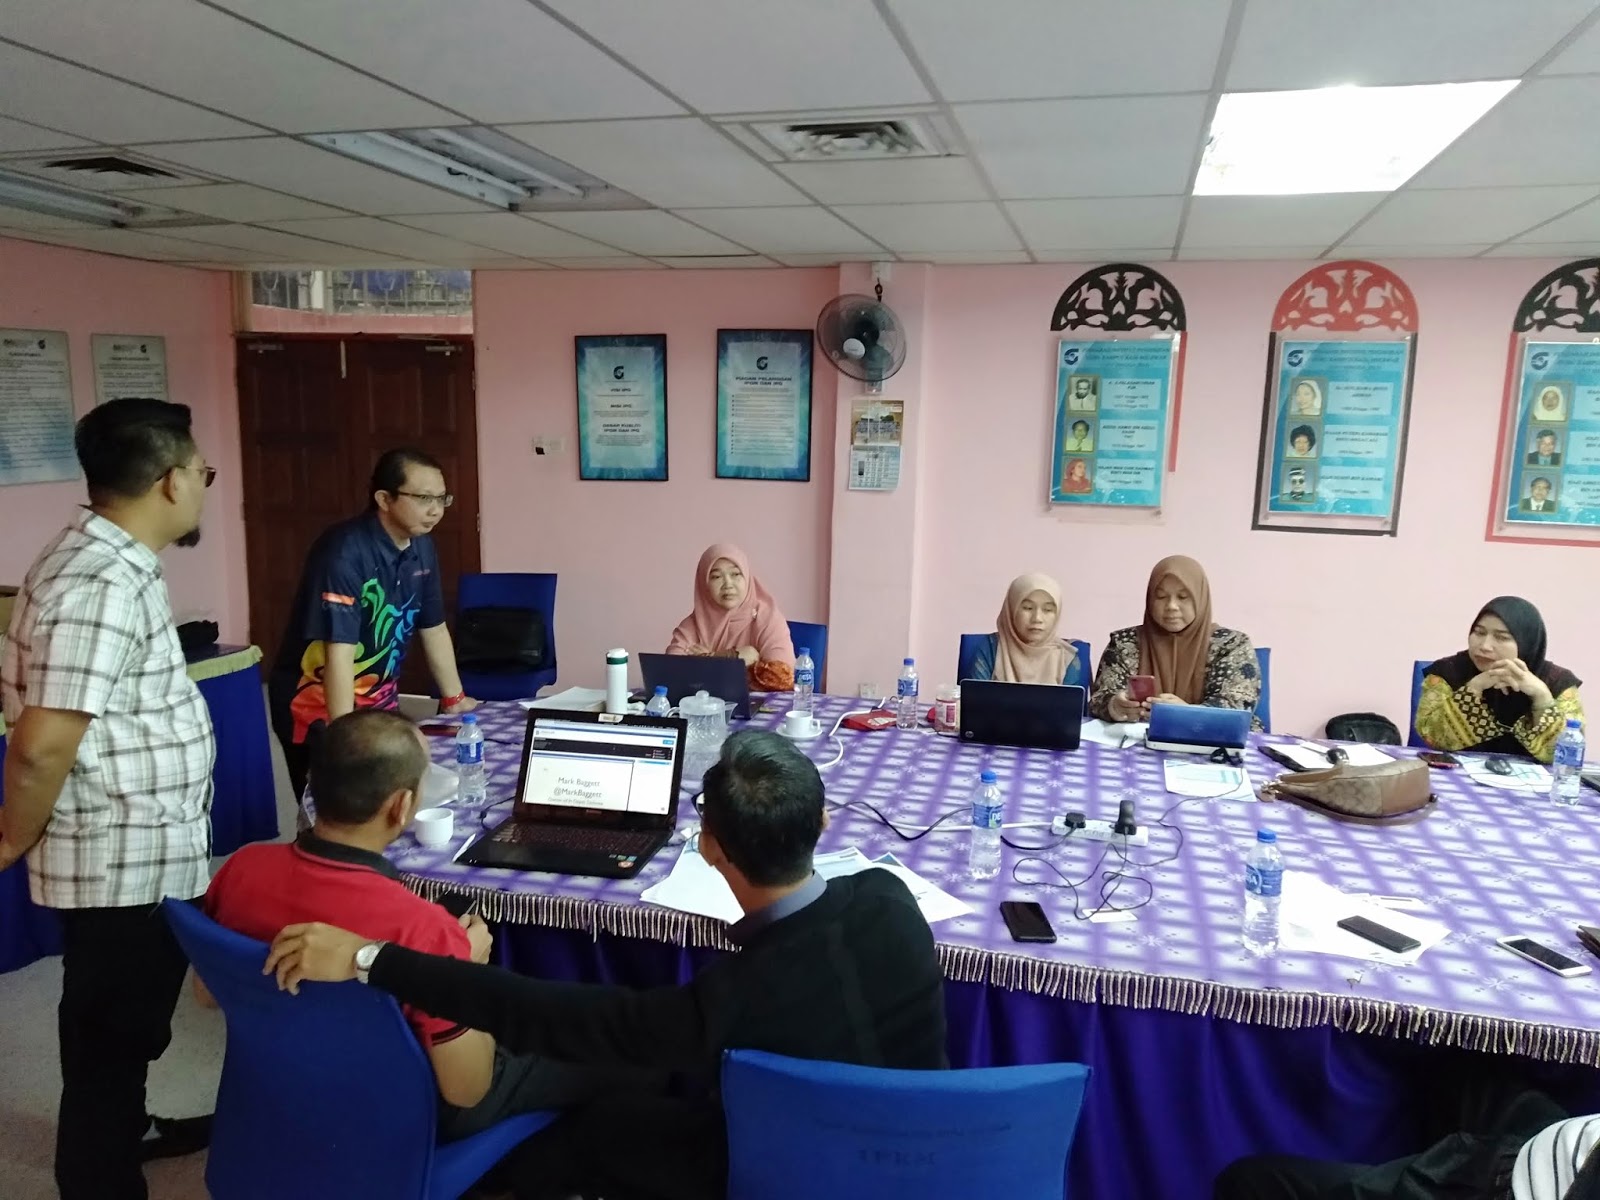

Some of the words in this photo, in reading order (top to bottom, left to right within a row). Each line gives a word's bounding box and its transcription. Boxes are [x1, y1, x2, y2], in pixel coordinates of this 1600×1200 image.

[558, 776, 574, 784] Mark
[577, 778, 600, 787] Baggett
[554, 787, 602, 798] @MarkBaggett
